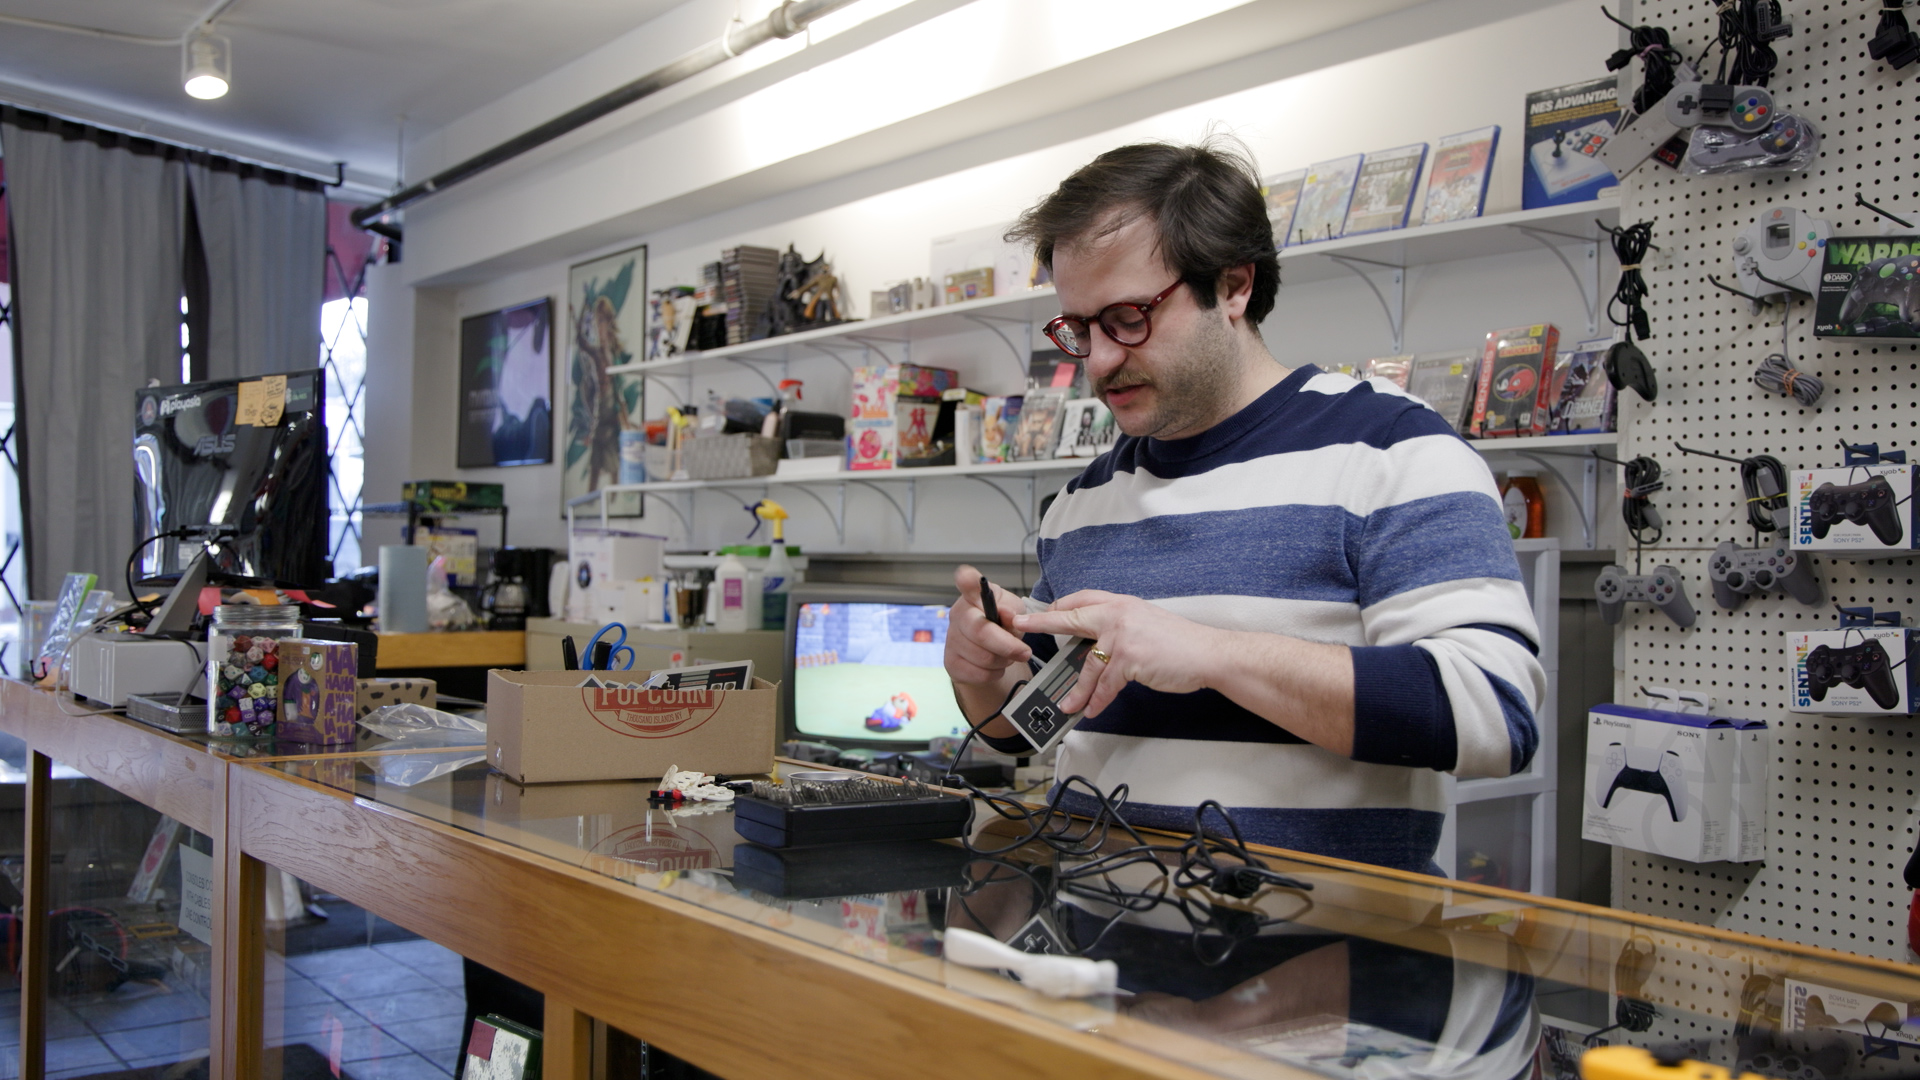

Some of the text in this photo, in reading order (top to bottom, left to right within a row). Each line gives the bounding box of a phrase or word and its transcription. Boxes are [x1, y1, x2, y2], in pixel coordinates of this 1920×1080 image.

[1530, 100, 1554, 115] NES
[1554, 87, 1617, 110] ADVANTAG
[1476, 351, 1495, 413] GENESIS
[194, 434, 237, 456] ASUS
[1880, 468, 1898, 476] xyab
[1873, 632, 1891, 640] xyab
[626, 711, 683, 724] THOUSAND ISLANDS NY
[1603, 720, 1632, 729] PlayStation
[1677, 730, 1701, 739] SONY
